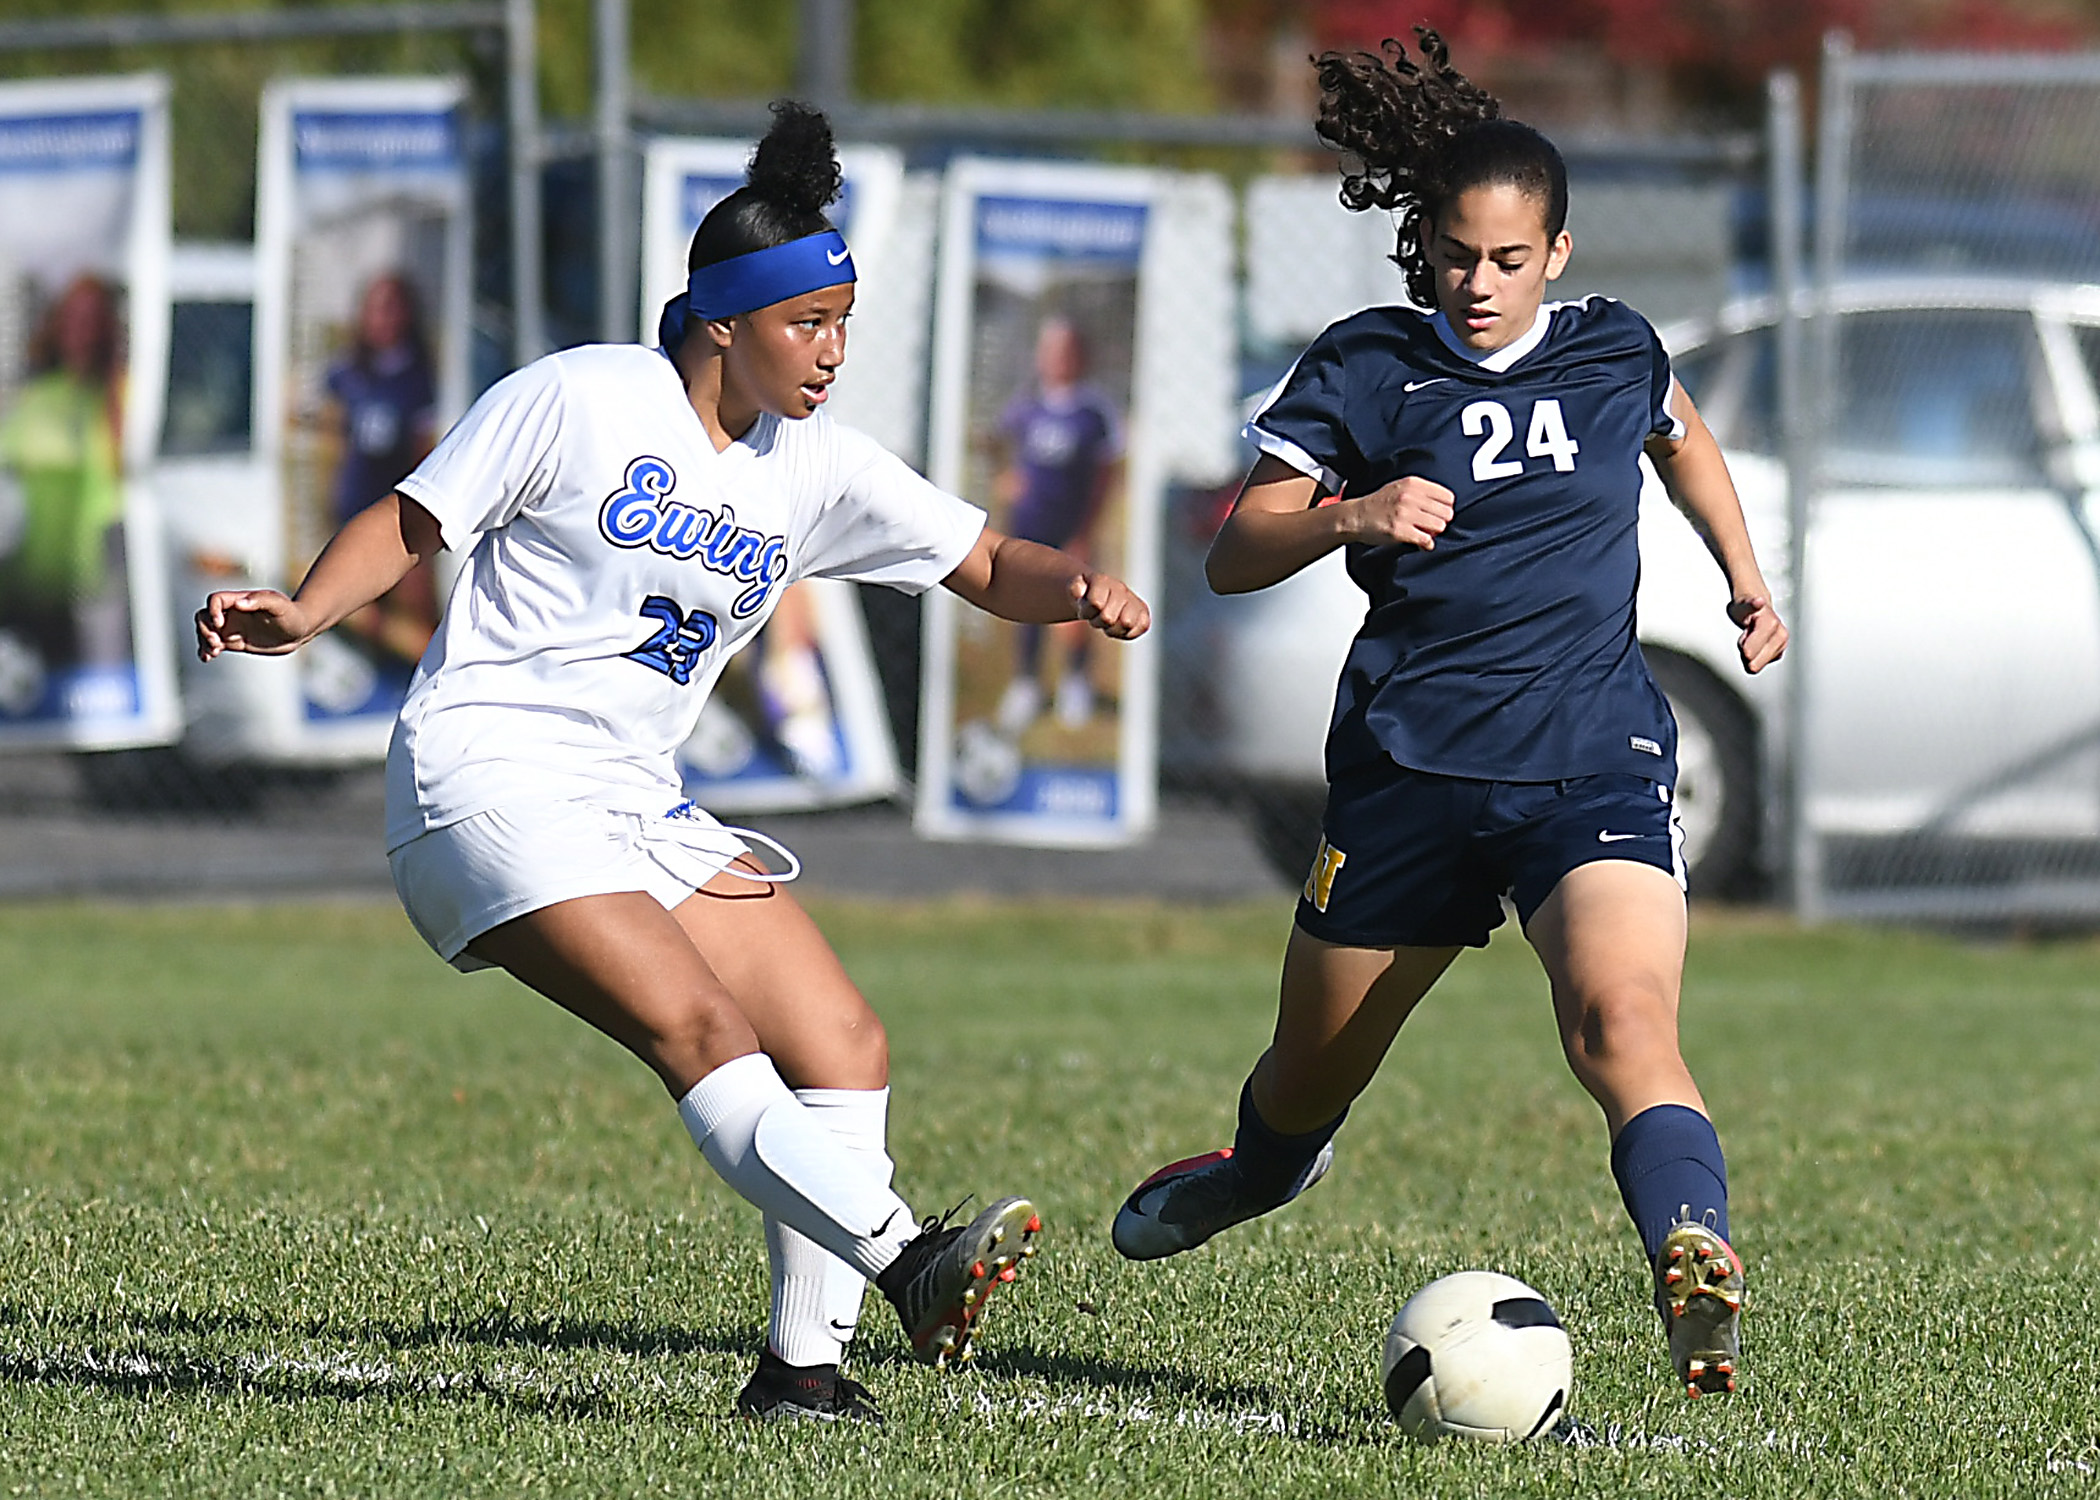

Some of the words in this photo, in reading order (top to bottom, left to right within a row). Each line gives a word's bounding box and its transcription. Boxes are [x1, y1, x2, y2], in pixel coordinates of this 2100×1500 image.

[1461, 399, 1579, 482] 24
[598, 454, 788, 619] Ewing
[1304, 832, 1347, 914] N
